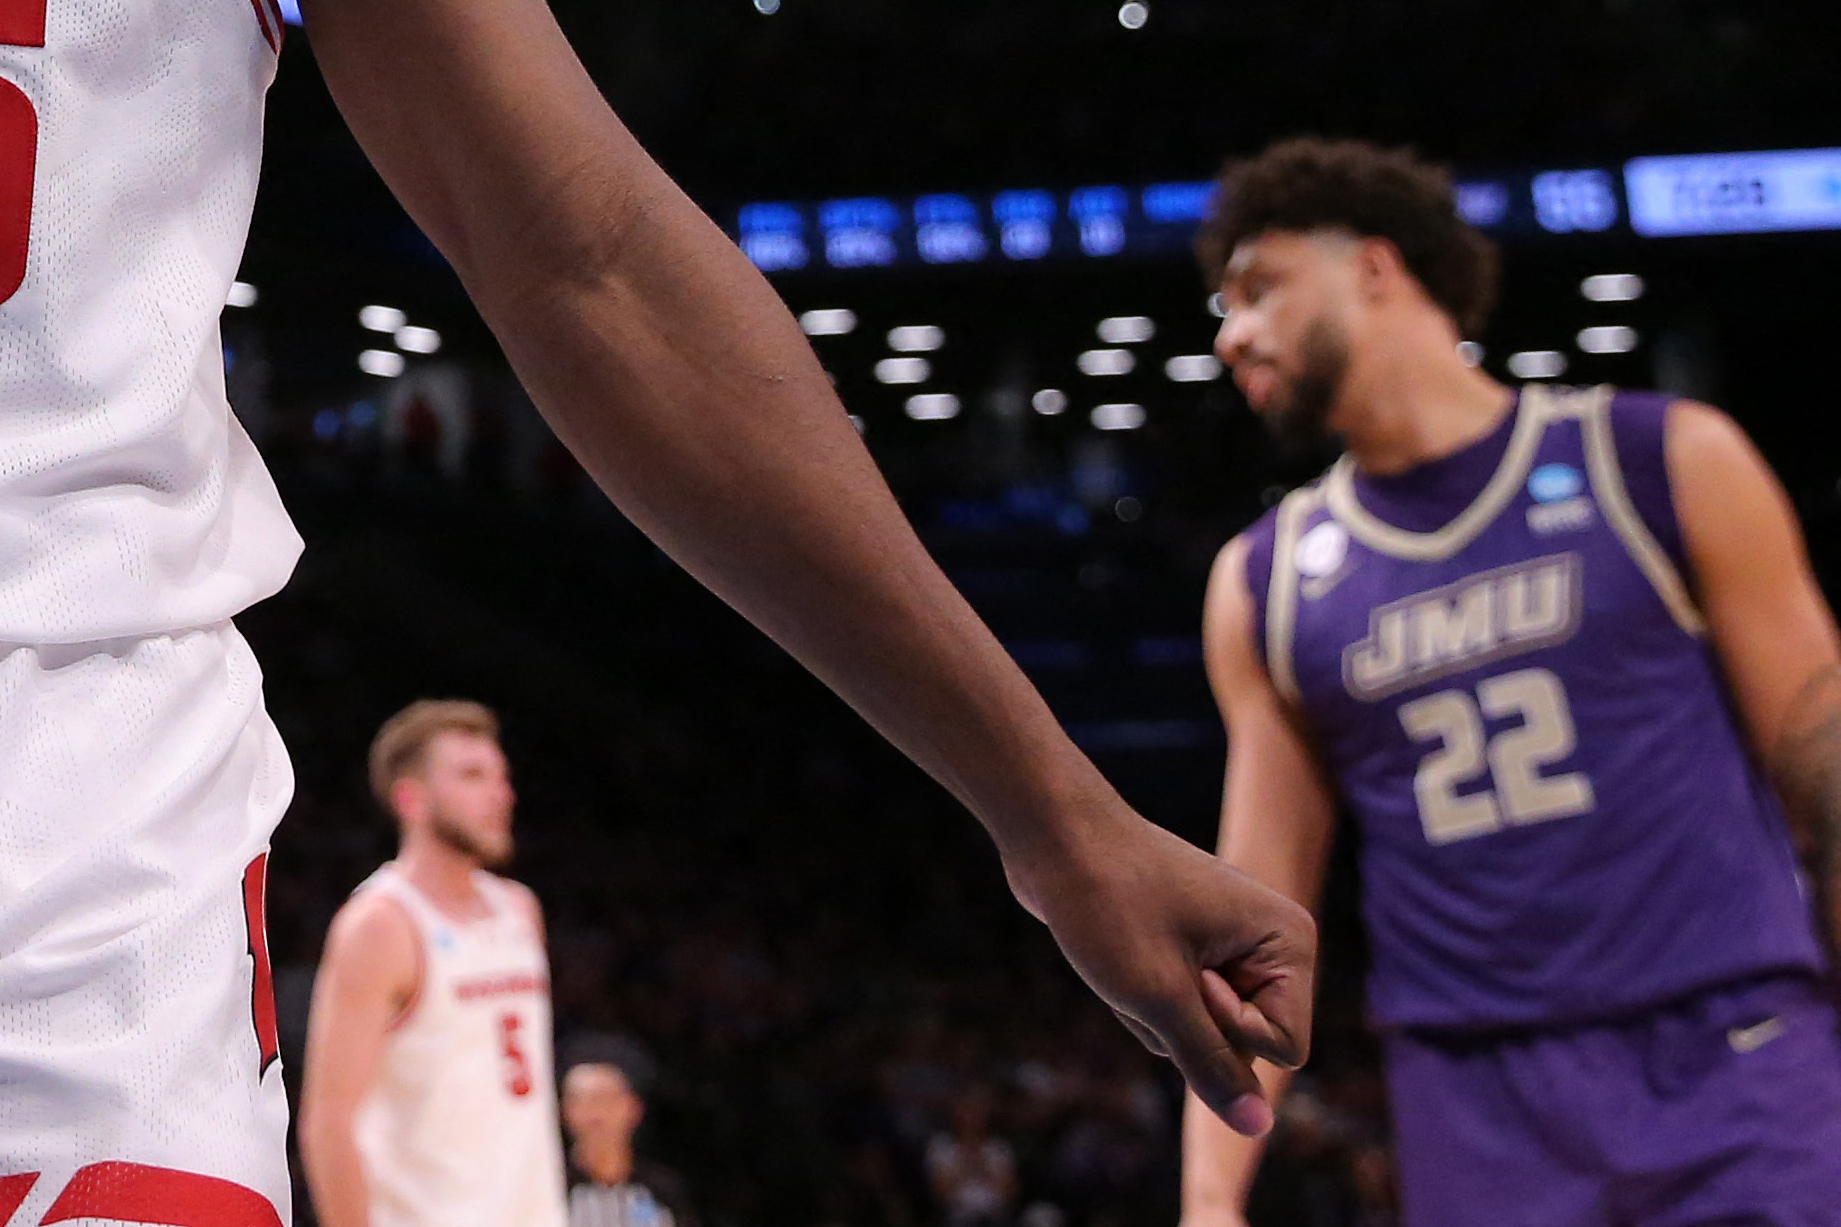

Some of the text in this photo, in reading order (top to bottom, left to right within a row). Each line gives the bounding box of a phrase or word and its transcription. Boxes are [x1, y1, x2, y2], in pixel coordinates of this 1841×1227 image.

[1347, 558, 1578, 696] JMU
[1398, 668, 1596, 846] 22
[500, 1012, 533, 1098] 5
